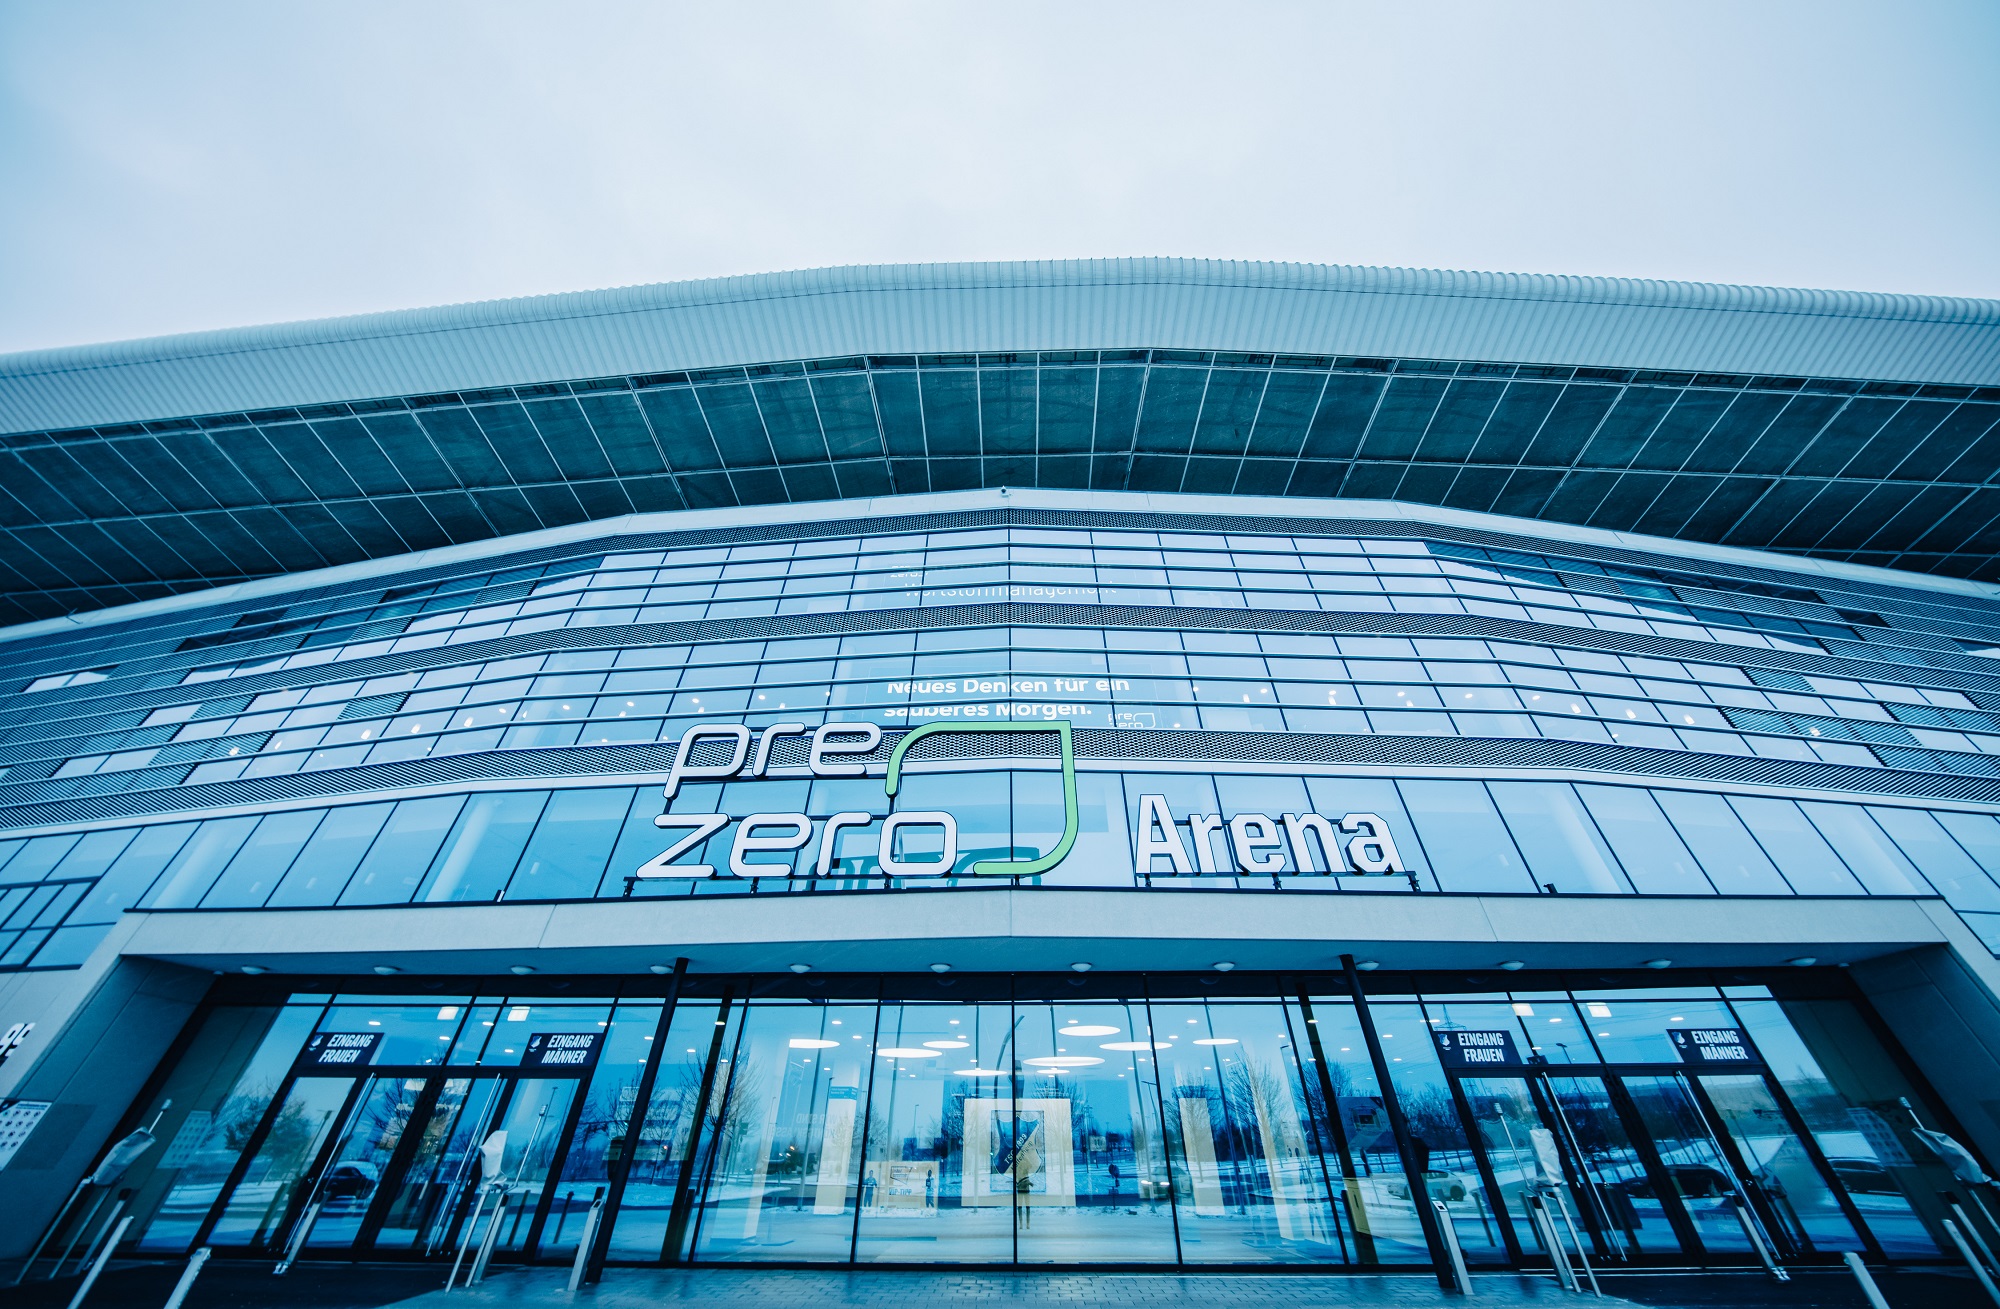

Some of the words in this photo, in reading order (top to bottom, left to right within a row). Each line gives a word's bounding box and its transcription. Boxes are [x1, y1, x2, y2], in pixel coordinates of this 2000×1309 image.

[887, 681, 957, 694] Neues
[963, 677, 1048, 693] Denken
[1054, 678, 1089, 692] für
[1095, 679, 1130, 692] ein
[884, 704, 989, 718] sauberes
[996, 703, 1092, 721] Morgen.
[663, 722, 882, 799] pre
[1134, 794, 1407, 875] Arena
[636, 811, 957, 877] zero
[327, 1034, 375, 1048] EINGANG
[547, 1034, 594, 1048] EINGANG
[1457, 1032, 1505, 1046] EINGANG
[1691, 1030, 1740, 1044] EINGANG
[318, 1049, 362, 1063] FRAUEN
[541, 1048, 588, 1064] MÄNNER
[1463, 1048, 1505, 1062] FRAUEN
[1700, 1043, 1749, 1060] MÄNNER
